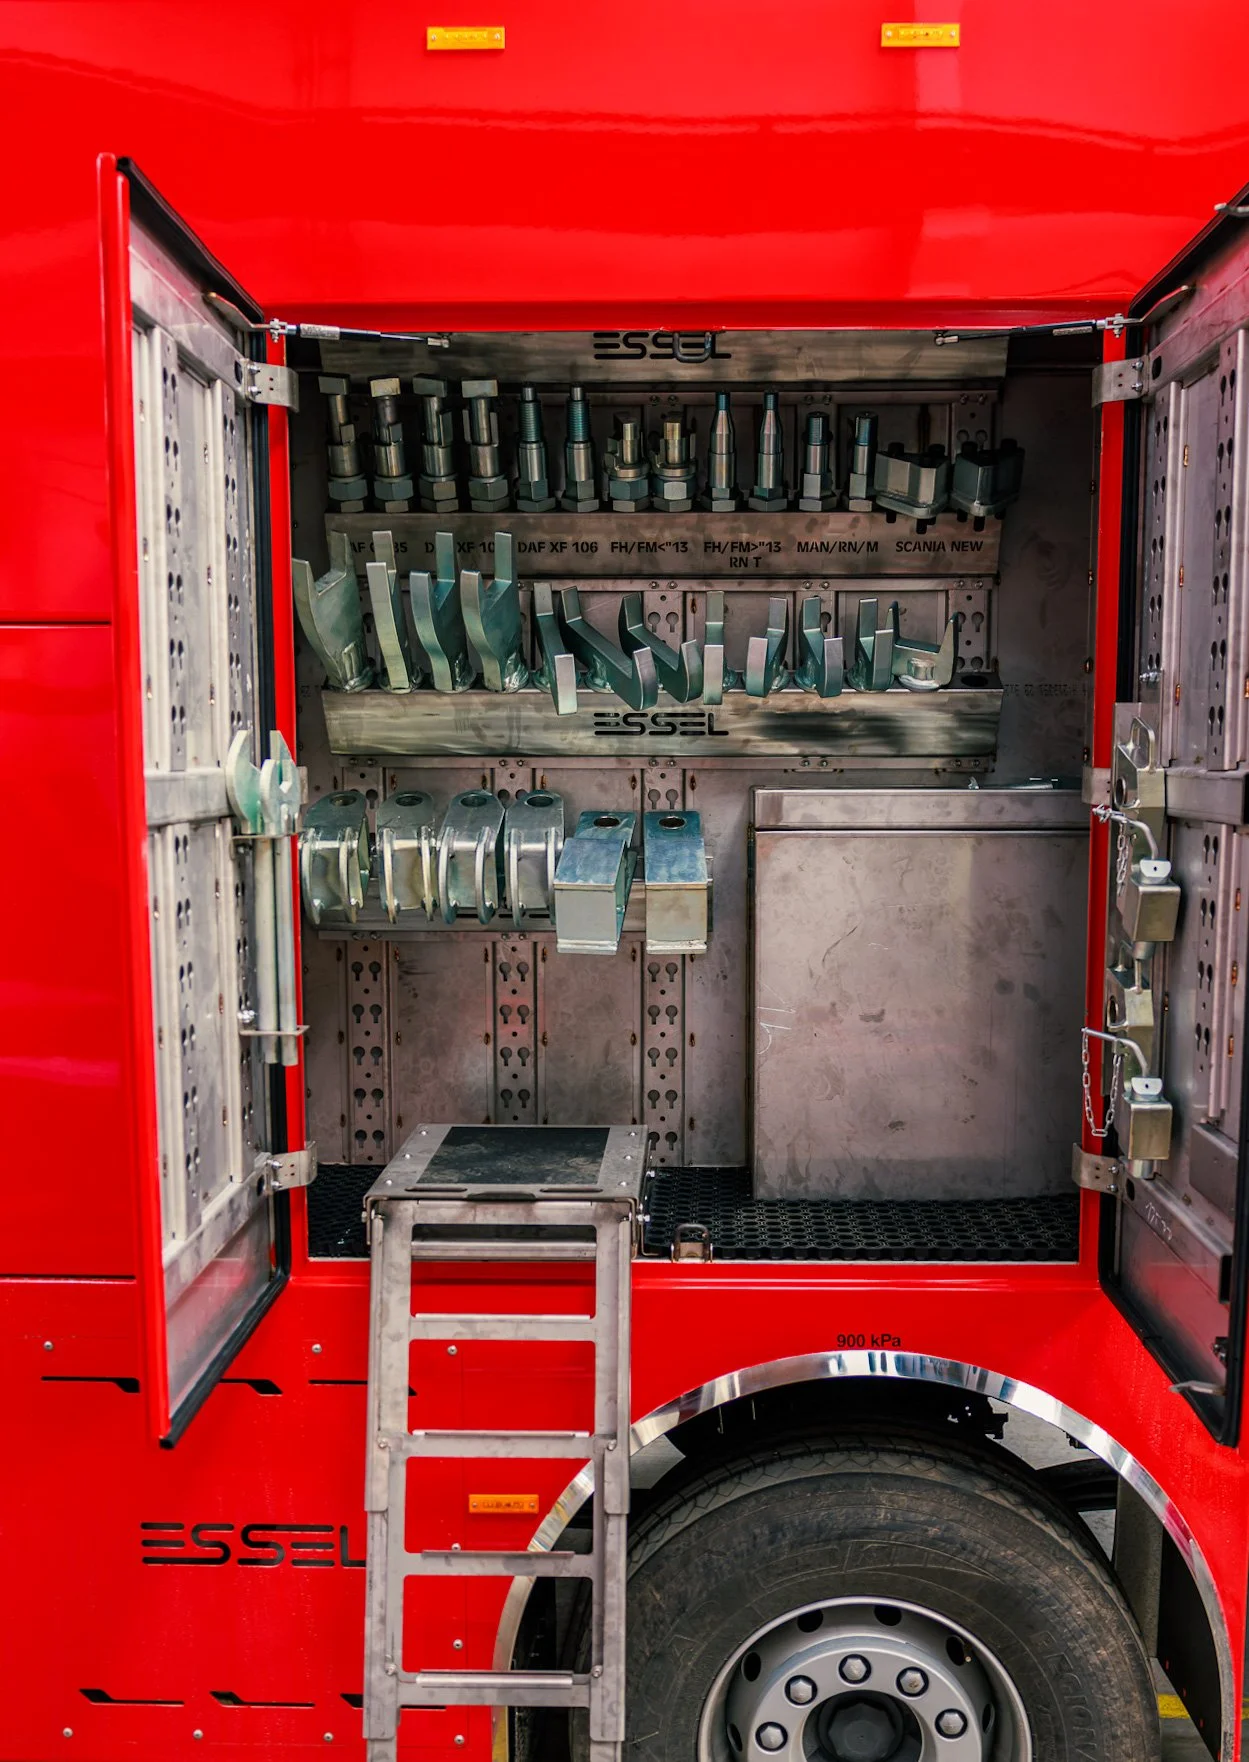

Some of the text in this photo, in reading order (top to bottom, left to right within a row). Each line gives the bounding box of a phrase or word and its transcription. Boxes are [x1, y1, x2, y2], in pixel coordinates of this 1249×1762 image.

[593, 331, 732, 359] ESSEL
[457, 541, 496, 553] XF 10
[517, 541, 598, 553] DAF XF 106
[796, 541, 879, 554] MAN/RN/M
[895, 541, 984, 553] SCANIA NEW
[729, 556, 762, 568] RN T
[593, 712, 729, 736] ESSEL
[836, 1333, 902, 1348] 900 kPa
[140, 1522, 367, 1567] ESSEL
